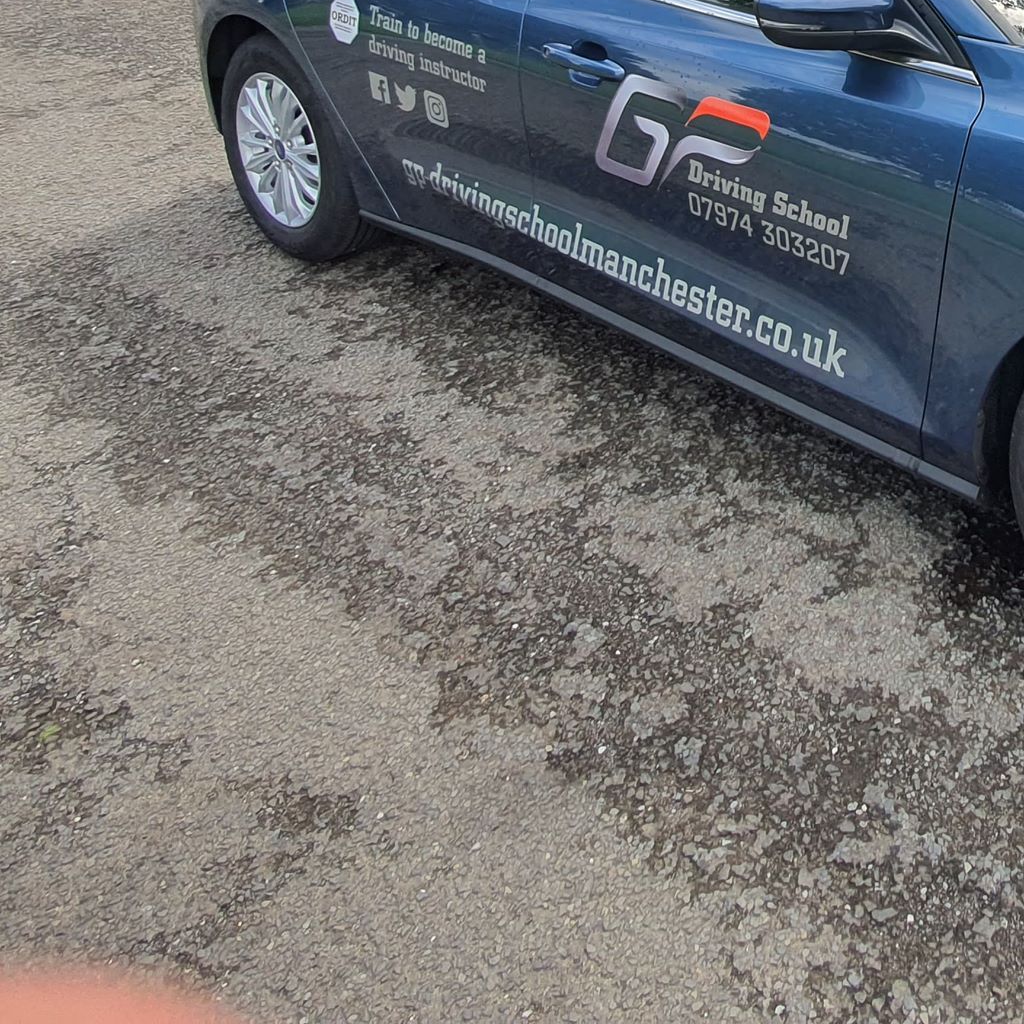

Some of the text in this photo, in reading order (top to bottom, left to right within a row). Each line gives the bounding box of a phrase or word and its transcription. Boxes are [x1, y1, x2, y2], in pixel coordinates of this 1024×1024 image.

[331, 10, 357, 28] ORDIT
[369, 4, 402, 35] Train
[407, 20, 419, 40] to
[424, 22, 473, 59] become
[477, 48, 486, 65] a
[368, 34, 487, 93] driving instructor
[594, 73, 771, 191] GP
[687, 158, 851, 240] Driving School
[687, 191, 850, 276] 07974 303207
[401, 158, 848, 378] gp-drivingschoolmanchester.co.uk
